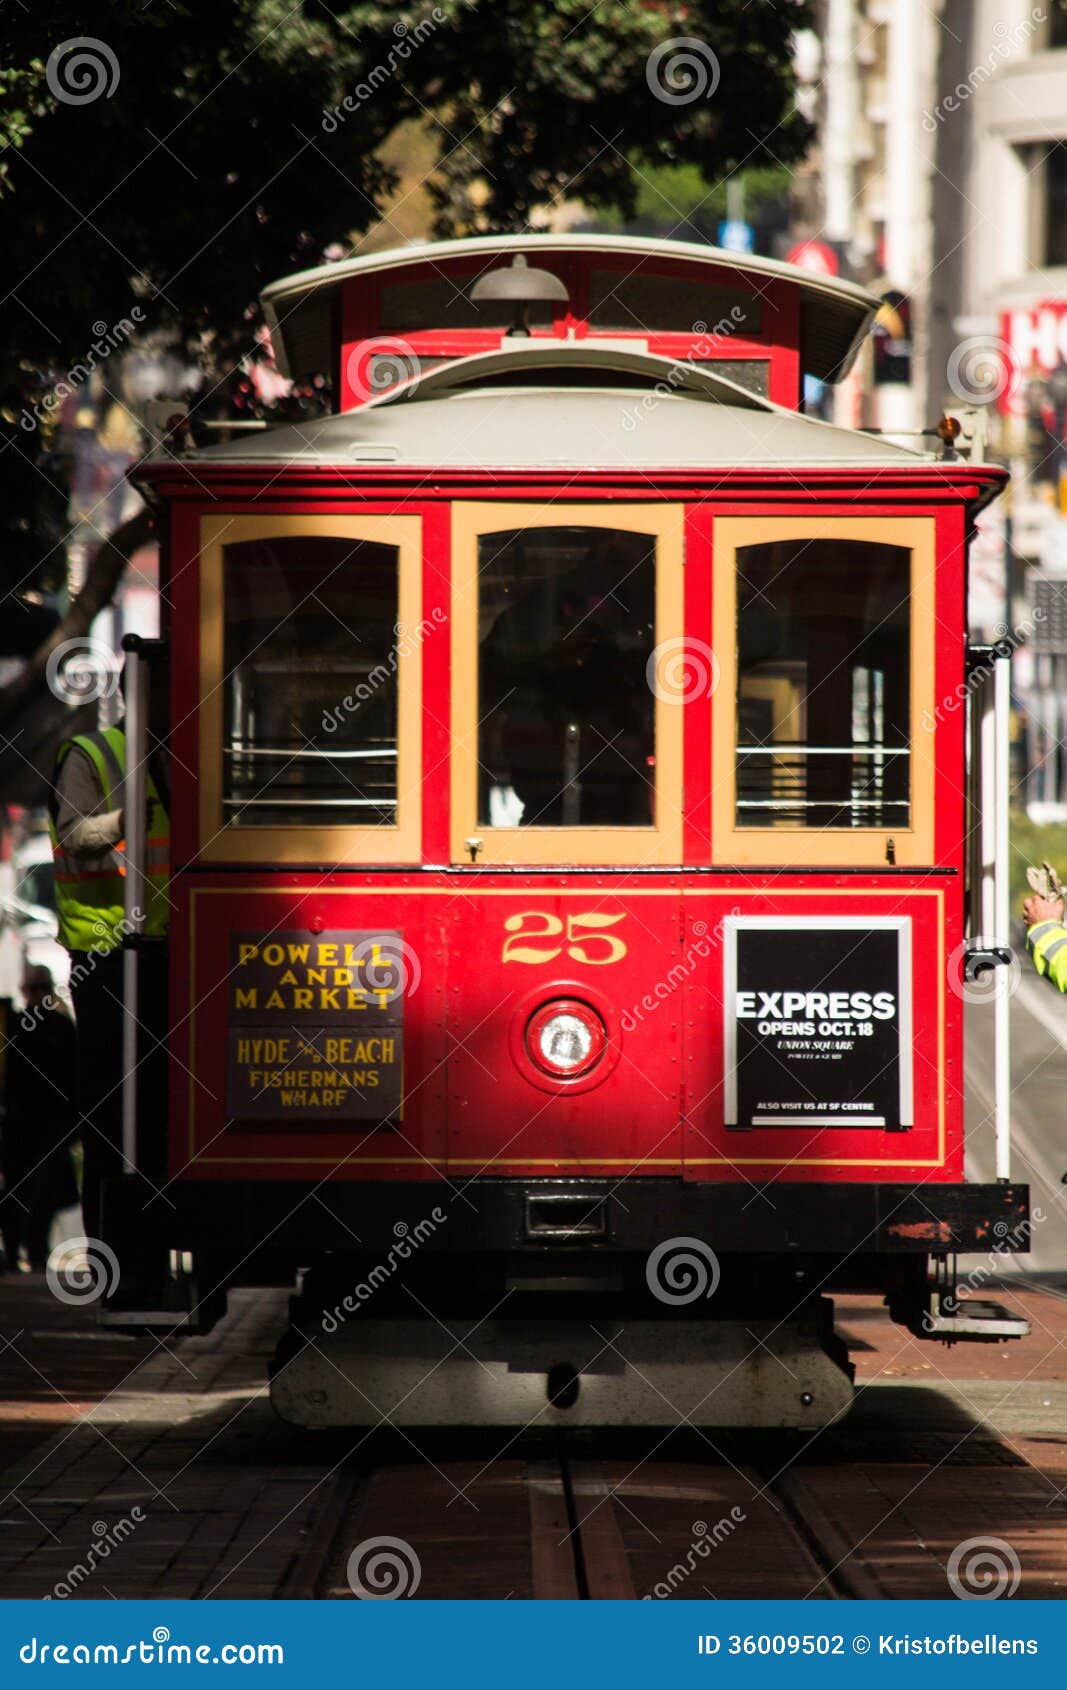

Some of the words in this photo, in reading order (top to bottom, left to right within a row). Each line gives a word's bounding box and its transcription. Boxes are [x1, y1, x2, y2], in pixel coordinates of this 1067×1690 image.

[502, 911, 627, 965] 25
[237, 943, 393, 967] POWELL
[280, 969, 354, 986] AND
[234, 989, 395, 1011] MARKET
[736, 991, 896, 1020] EXPRESS
[757, 1021, 816, 1036] OPENS
[237, 1039, 289, 1063] HYDE
[326, 1039, 395, 1063] BEACH
[777, 1040, 811, 1050] UNION
[811, 1040, 854, 1052] SQUARE
[250, 1070, 379, 1088] FISHERMANS
[280, 1089, 347, 1107] WHARF
[842, 1103, 874, 1111] CENTRE
